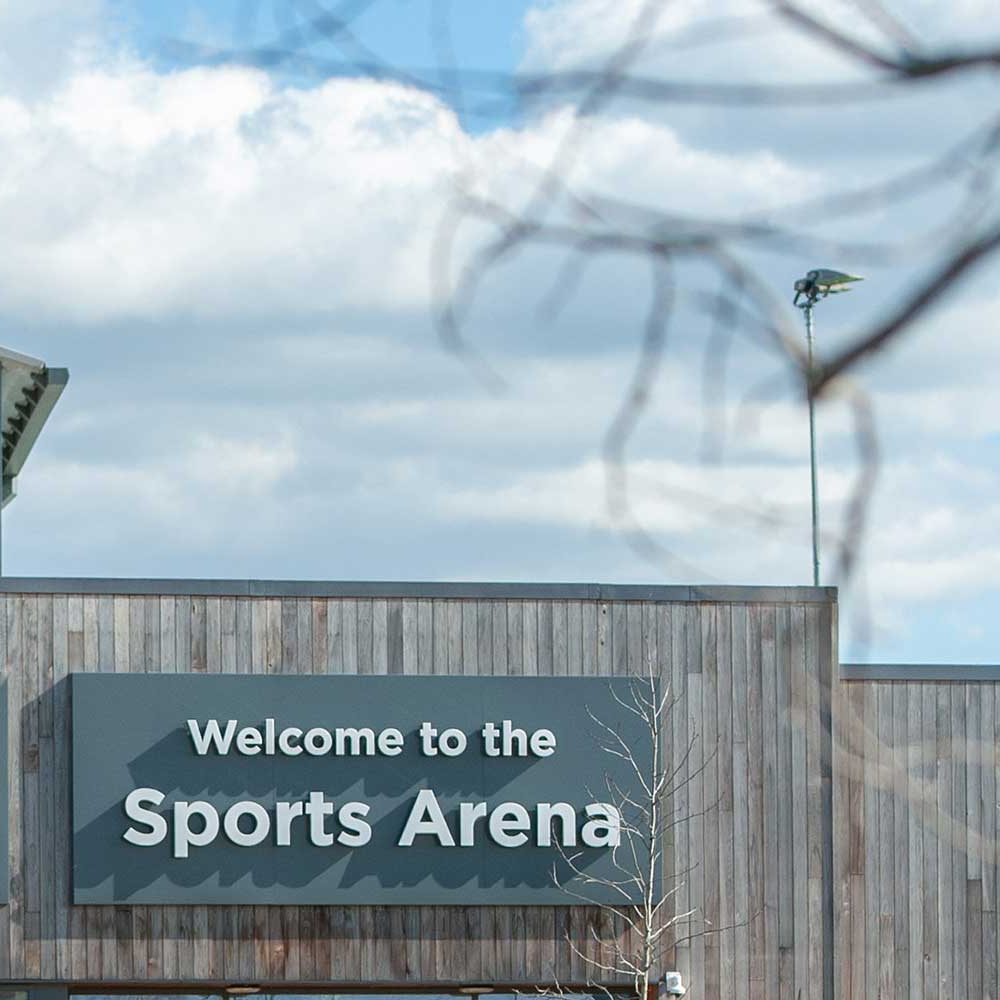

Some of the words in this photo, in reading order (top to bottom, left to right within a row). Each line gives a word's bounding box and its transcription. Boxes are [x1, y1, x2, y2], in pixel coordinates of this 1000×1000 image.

[187, 719, 404, 755] Welcome
[420, 721, 467, 756] to
[483, 720, 557, 757] the
[123, 788, 372, 858] Sports
[398, 789, 621, 847] Arena
